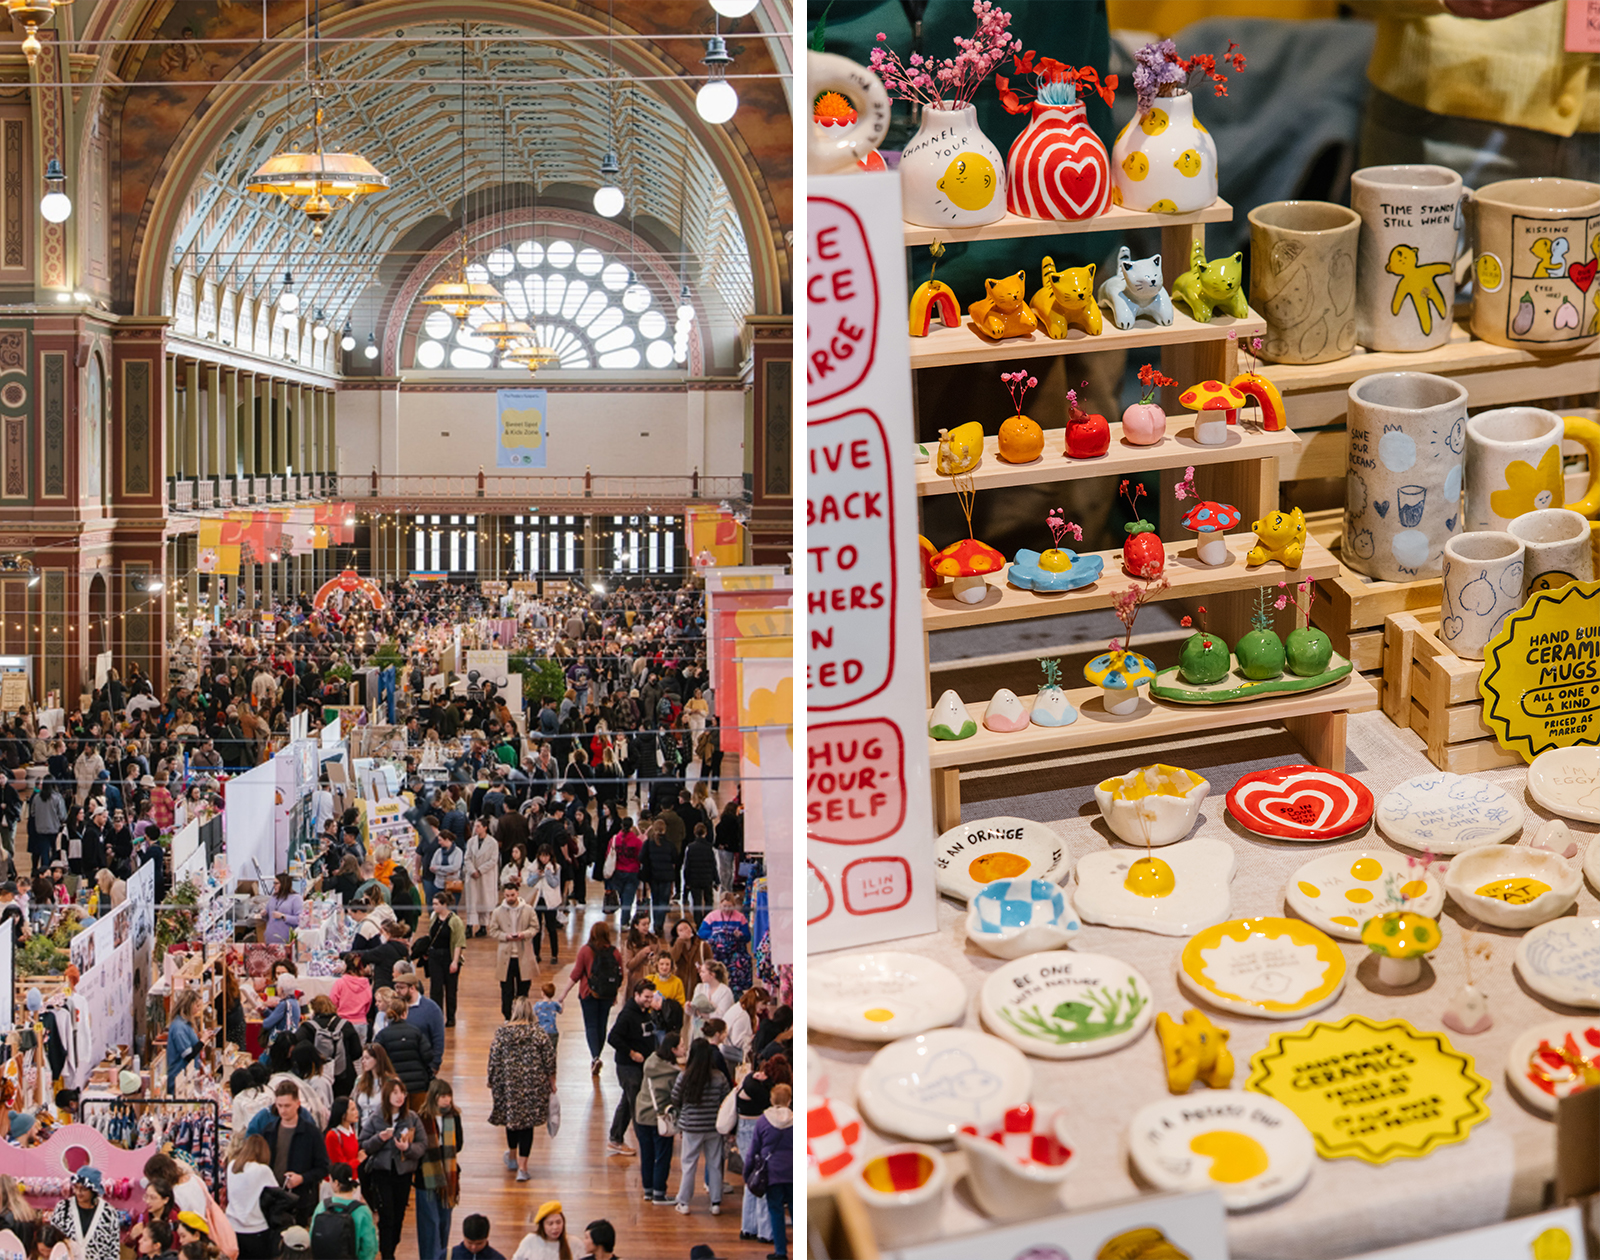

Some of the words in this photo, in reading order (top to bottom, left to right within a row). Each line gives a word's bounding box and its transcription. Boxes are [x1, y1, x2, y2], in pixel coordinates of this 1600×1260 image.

[903, 127, 957, 158] CHANNEL
[935, 137, 969, 159] YOUR
[1380, 203, 1413, 215] TIME
[1420, 203, 1455, 215] STANDS
[1383, 217, 1414, 228] STILL
[1421, 214, 1451, 226] WHEN
[1525, 226, 1570, 234] KISSING
[807, 316, 866, 386] RGE
[1351, 428, 1370, 443] SAVE
[1352, 443, 1369, 454] OUR
[1348, 452, 1377, 470] OCEANS
[807, 544, 858, 574] TO
[1530, 629, 1570, 647] HAND
[1539, 660, 1597, 685] MUGS
[1533, 692, 1555, 703] ALL
[1558, 687, 1584, 699] ONE
[1544, 702, 1554, 713] A
[1561, 697, 1591, 710] KIND
[1544, 716, 1577, 729] PRICED
[1580, 713, 1593, 724] AS
[1549, 724, 1588, 737] MARKED
[808, 737, 883, 769] HUG
[1562, 764, 1587, 777] I'M
[1552, 776, 1596, 785] EGGY
[807, 792, 887, 824] SELF
[1287, 809, 1313, 817] LOVE
[1411, 807, 1447, 818] TAKE
[1448, 801, 1477, 812] EACH
[1420, 815, 1444, 826] DAY
[1450, 811, 1464, 820] AS
[1468, 807, 1481, 816] IT
[1440, 817, 1480, 830] COMES
[946, 841, 965, 858] AN
[967, 827, 1025, 845] ORANGE
[1013, 974, 1031, 988] BE
[1040, 963, 1073, 978] ONE
[1292, 1051, 1416, 1091] CERAMICS
